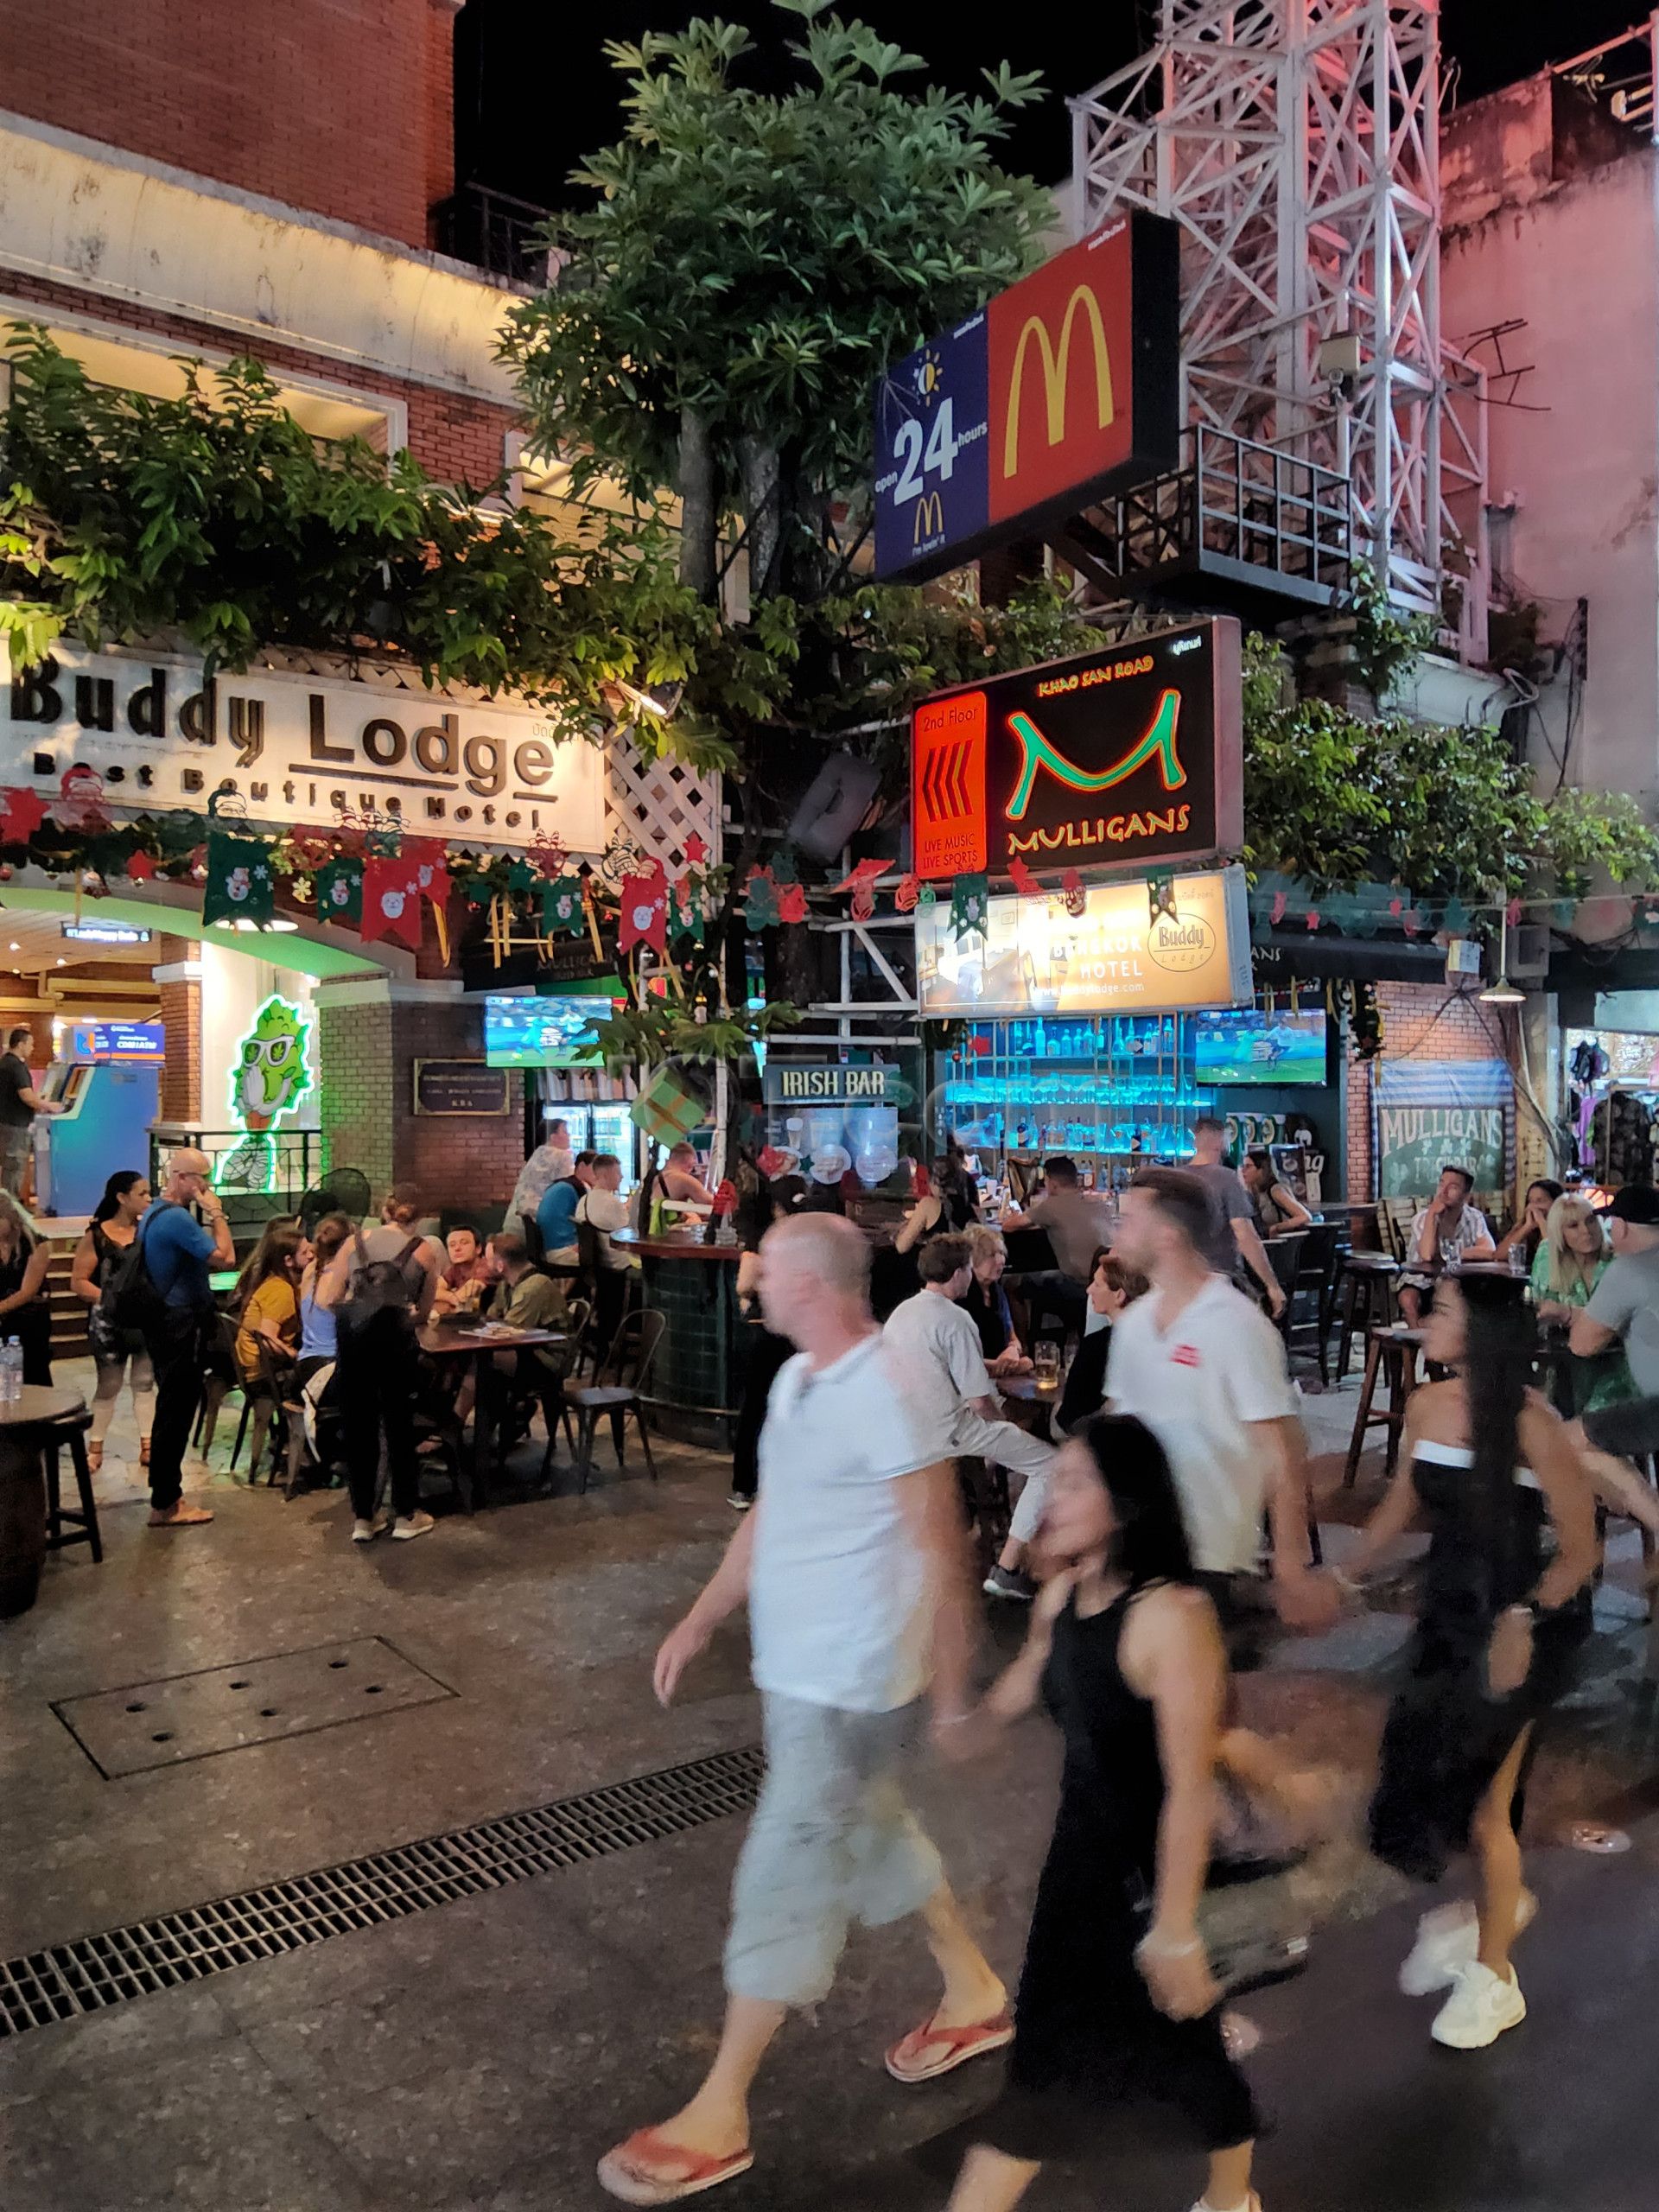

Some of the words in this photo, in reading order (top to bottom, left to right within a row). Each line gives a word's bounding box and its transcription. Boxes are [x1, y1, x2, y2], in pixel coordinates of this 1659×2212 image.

[874, 471, 898, 493] open
[893, 397, 958, 505] 24
[958, 422, 988, 448] hours
[1039, 674, 1078, 697] KHAO
[1082, 664, 1112, 690] SAN
[1114, 655, 1154, 680] ROAD
[10, 653, 266, 768] Buddy
[923, 712, 944, 733] 2nd
[949, 707, 978, 723] Floor
[309, 694, 556, 798] Lodge
[182, 768, 403, 813] Boutique
[424, 796, 541, 830] Hotel
[925, 838, 942, 853] LIVE
[944, 833, 975, 849] MUSIC
[1007, 804, 1192, 856] MULLIGANS
[923, 855, 941, 869] LIVE
[943, 850, 978, 866] SPORTS
[1159, 925, 1205, 949] Buddy
[1079, 959, 1144, 979] HOTEL
[783, 1071, 838, 1096] IRISH
[846, 1071, 885, 1096] BAR
[1381, 1109, 1503, 1159] MULLIGANS
